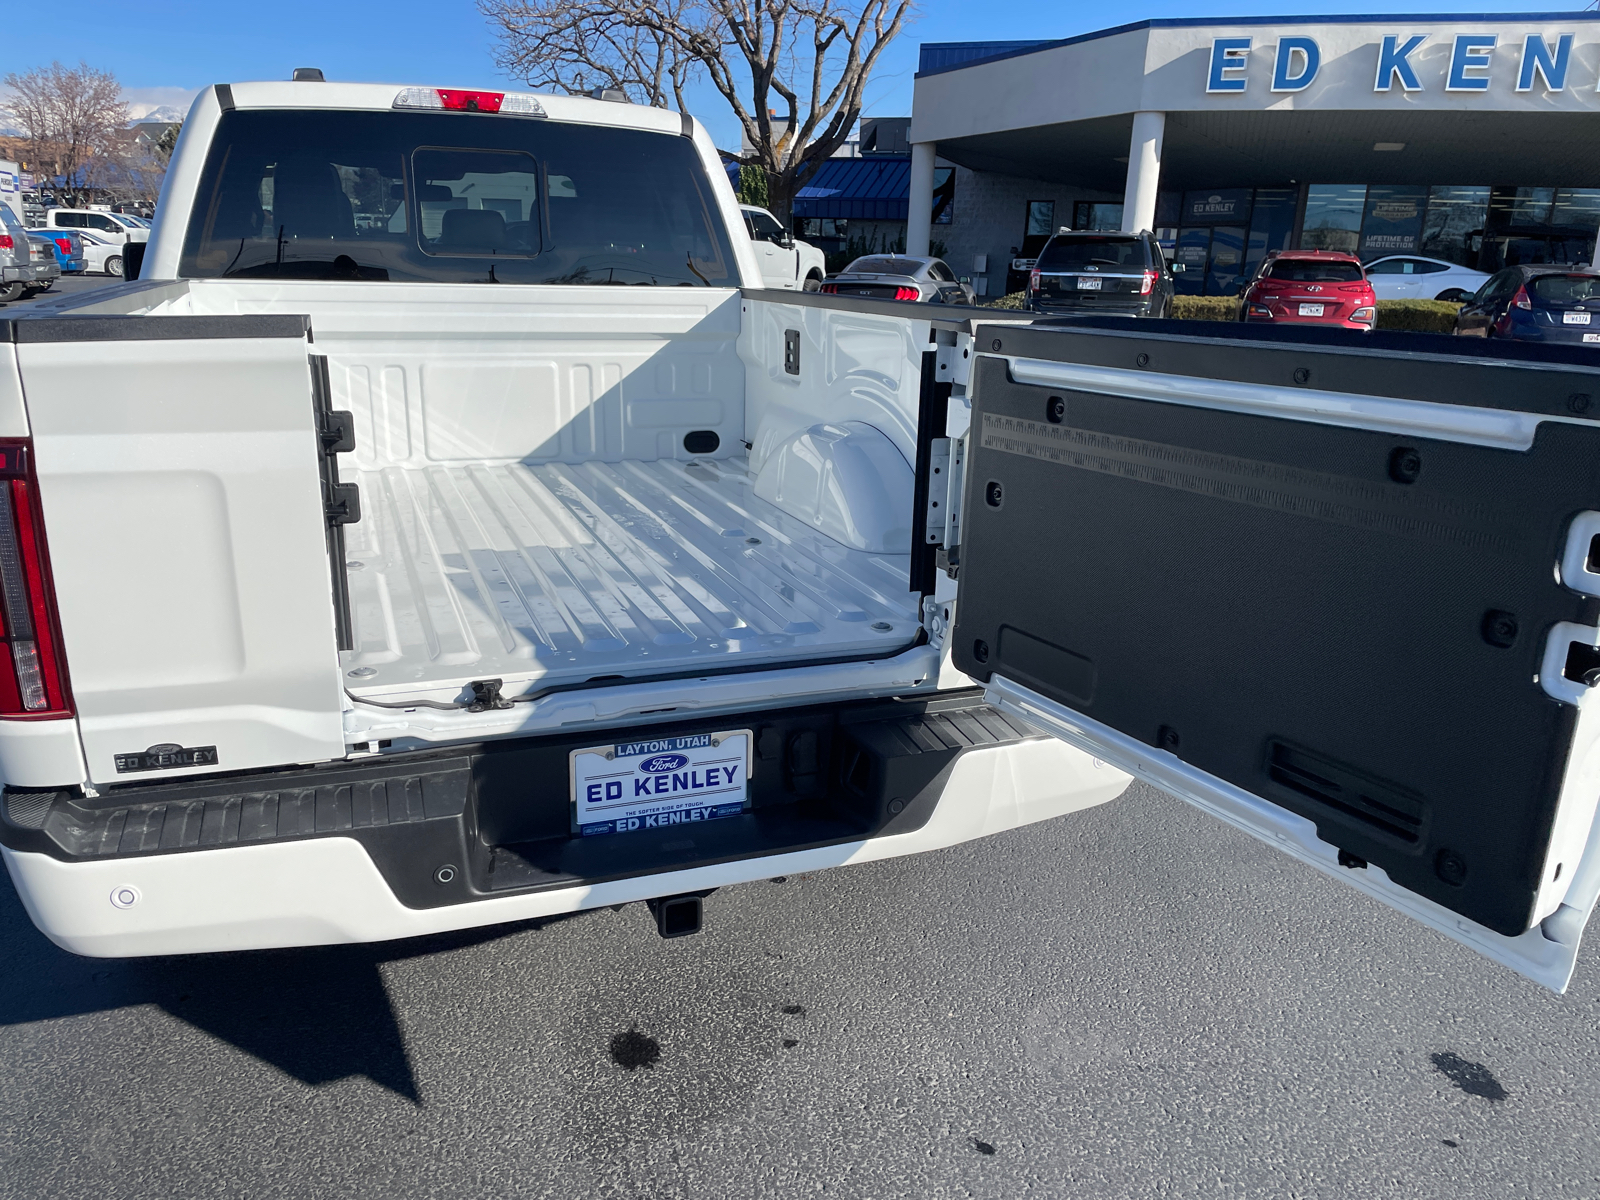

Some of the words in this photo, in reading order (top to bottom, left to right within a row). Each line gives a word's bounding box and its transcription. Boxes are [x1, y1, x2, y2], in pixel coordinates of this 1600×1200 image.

[1206, 35, 1322, 93] ED
[1374, 32, 1600, 93] KEN
[1193, 204, 1204, 213] ED
[1205, 203, 1235, 212] KENLEY
[617, 741, 672, 756] LAYTON,
[676, 735, 710, 748] UTAH
[116, 758, 139, 769] ED
[146, 750, 215, 767] KENLEY
[649, 757, 680, 771] Ford
[587, 780, 622, 803] ED
[634, 765, 739, 796] KENLEY
[616, 818, 640, 832] ED
[645, 807, 712, 828] KENLEY
[638, 807, 660, 815] SOFTER
